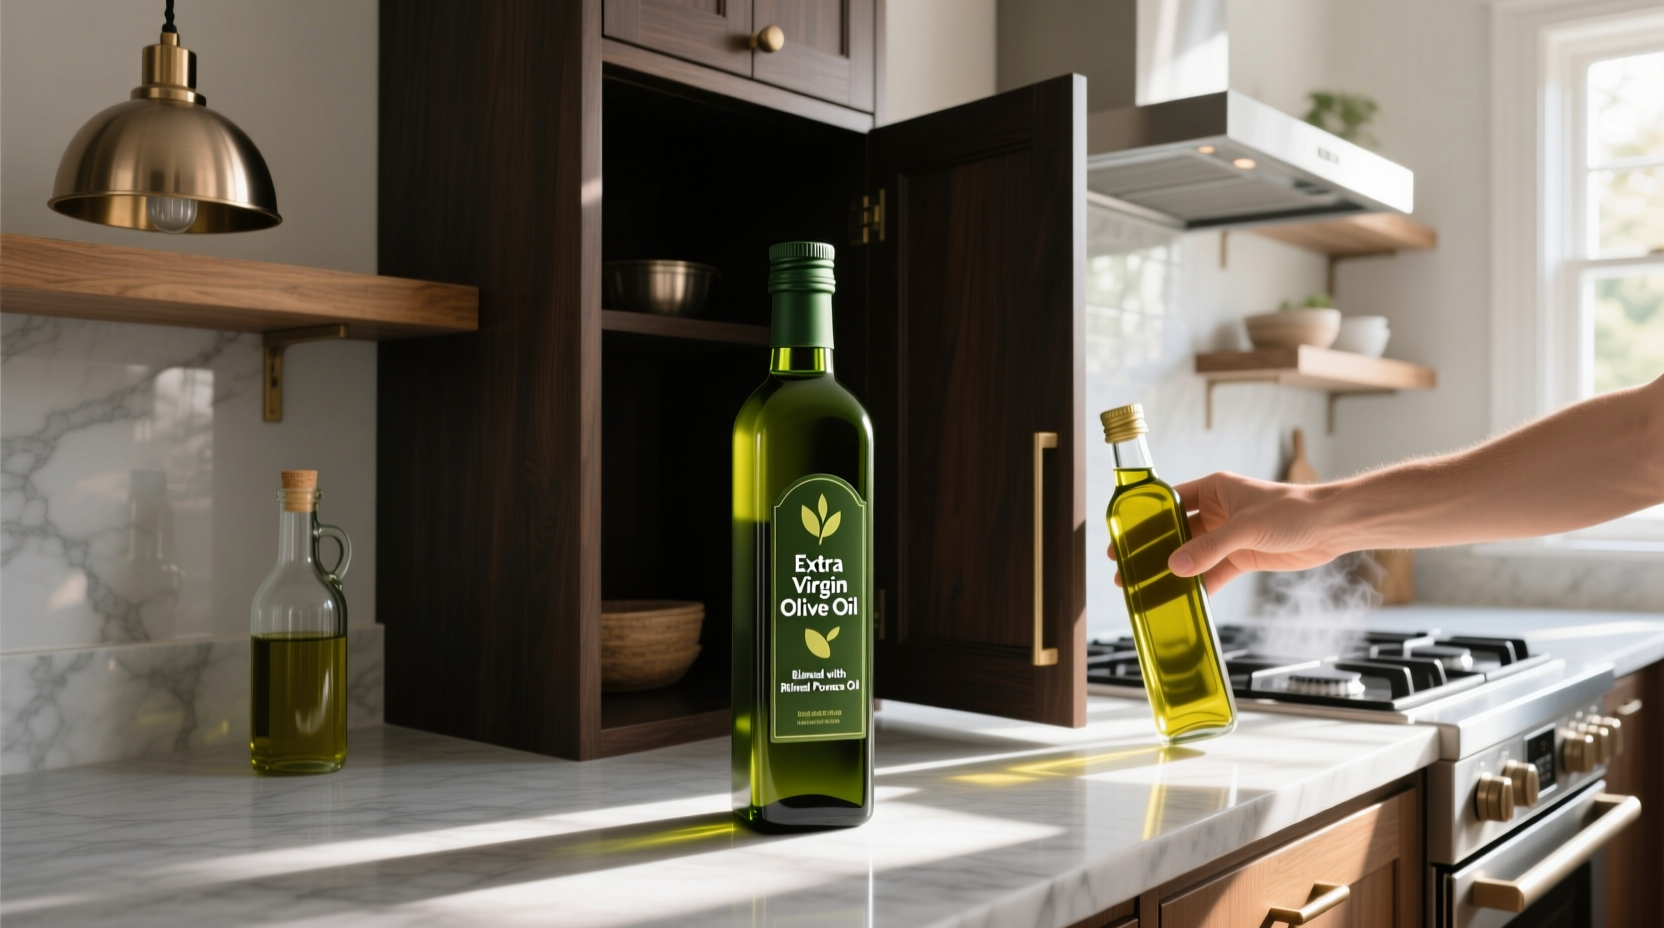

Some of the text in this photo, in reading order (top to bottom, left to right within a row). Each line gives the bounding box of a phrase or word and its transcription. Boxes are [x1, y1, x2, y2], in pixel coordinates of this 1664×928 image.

[795, 553, 844, 573] Extra
[791, 575, 848, 599] Virgin
[780, 596, 858, 617] Olive Oil
